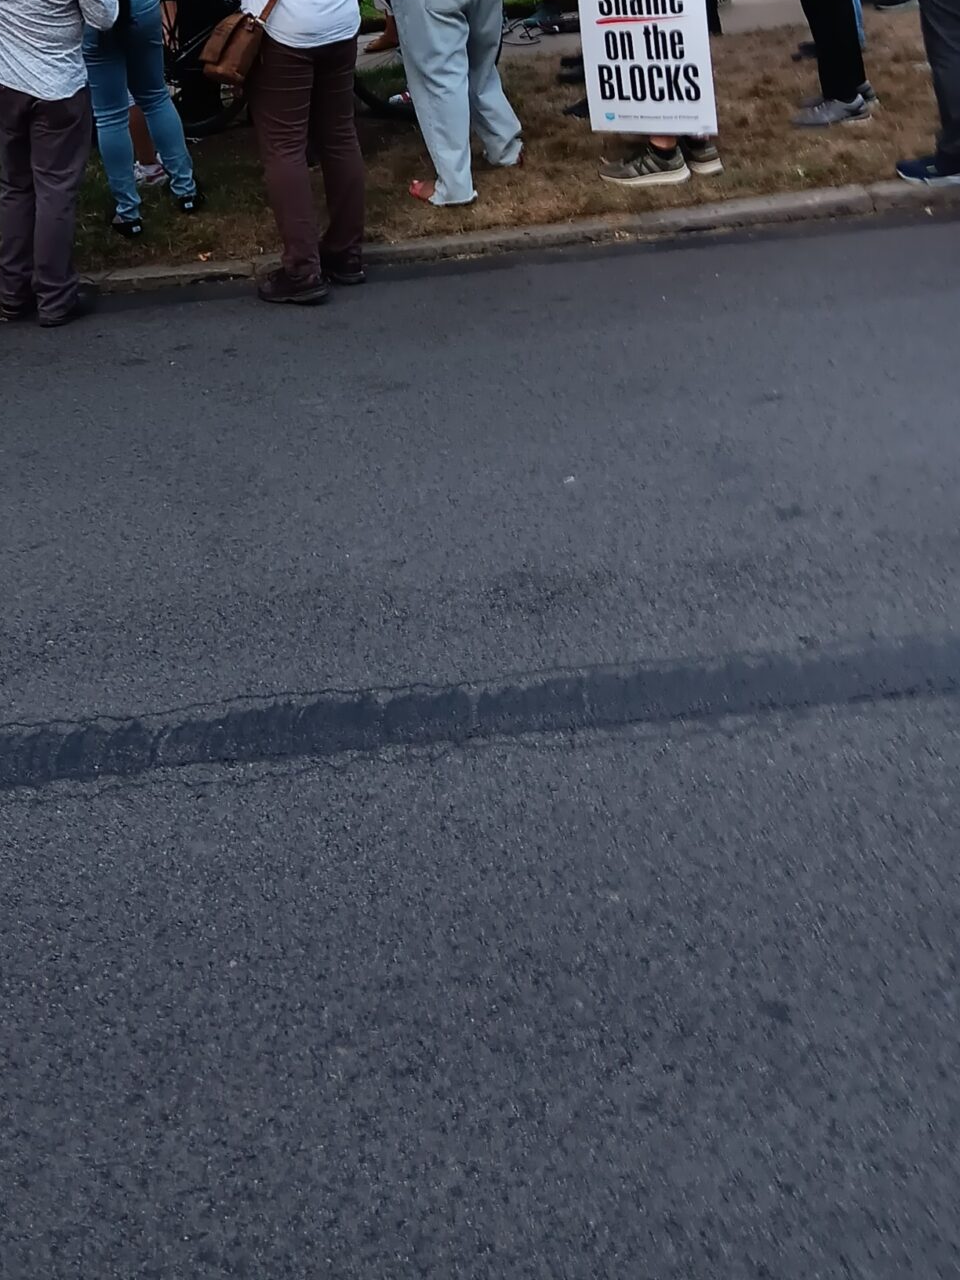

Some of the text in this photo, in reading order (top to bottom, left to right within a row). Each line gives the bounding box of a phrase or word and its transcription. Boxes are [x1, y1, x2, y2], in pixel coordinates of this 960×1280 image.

[604, 23, 685, 61] on the
[597, 63, 701, 102] BLOCKS
